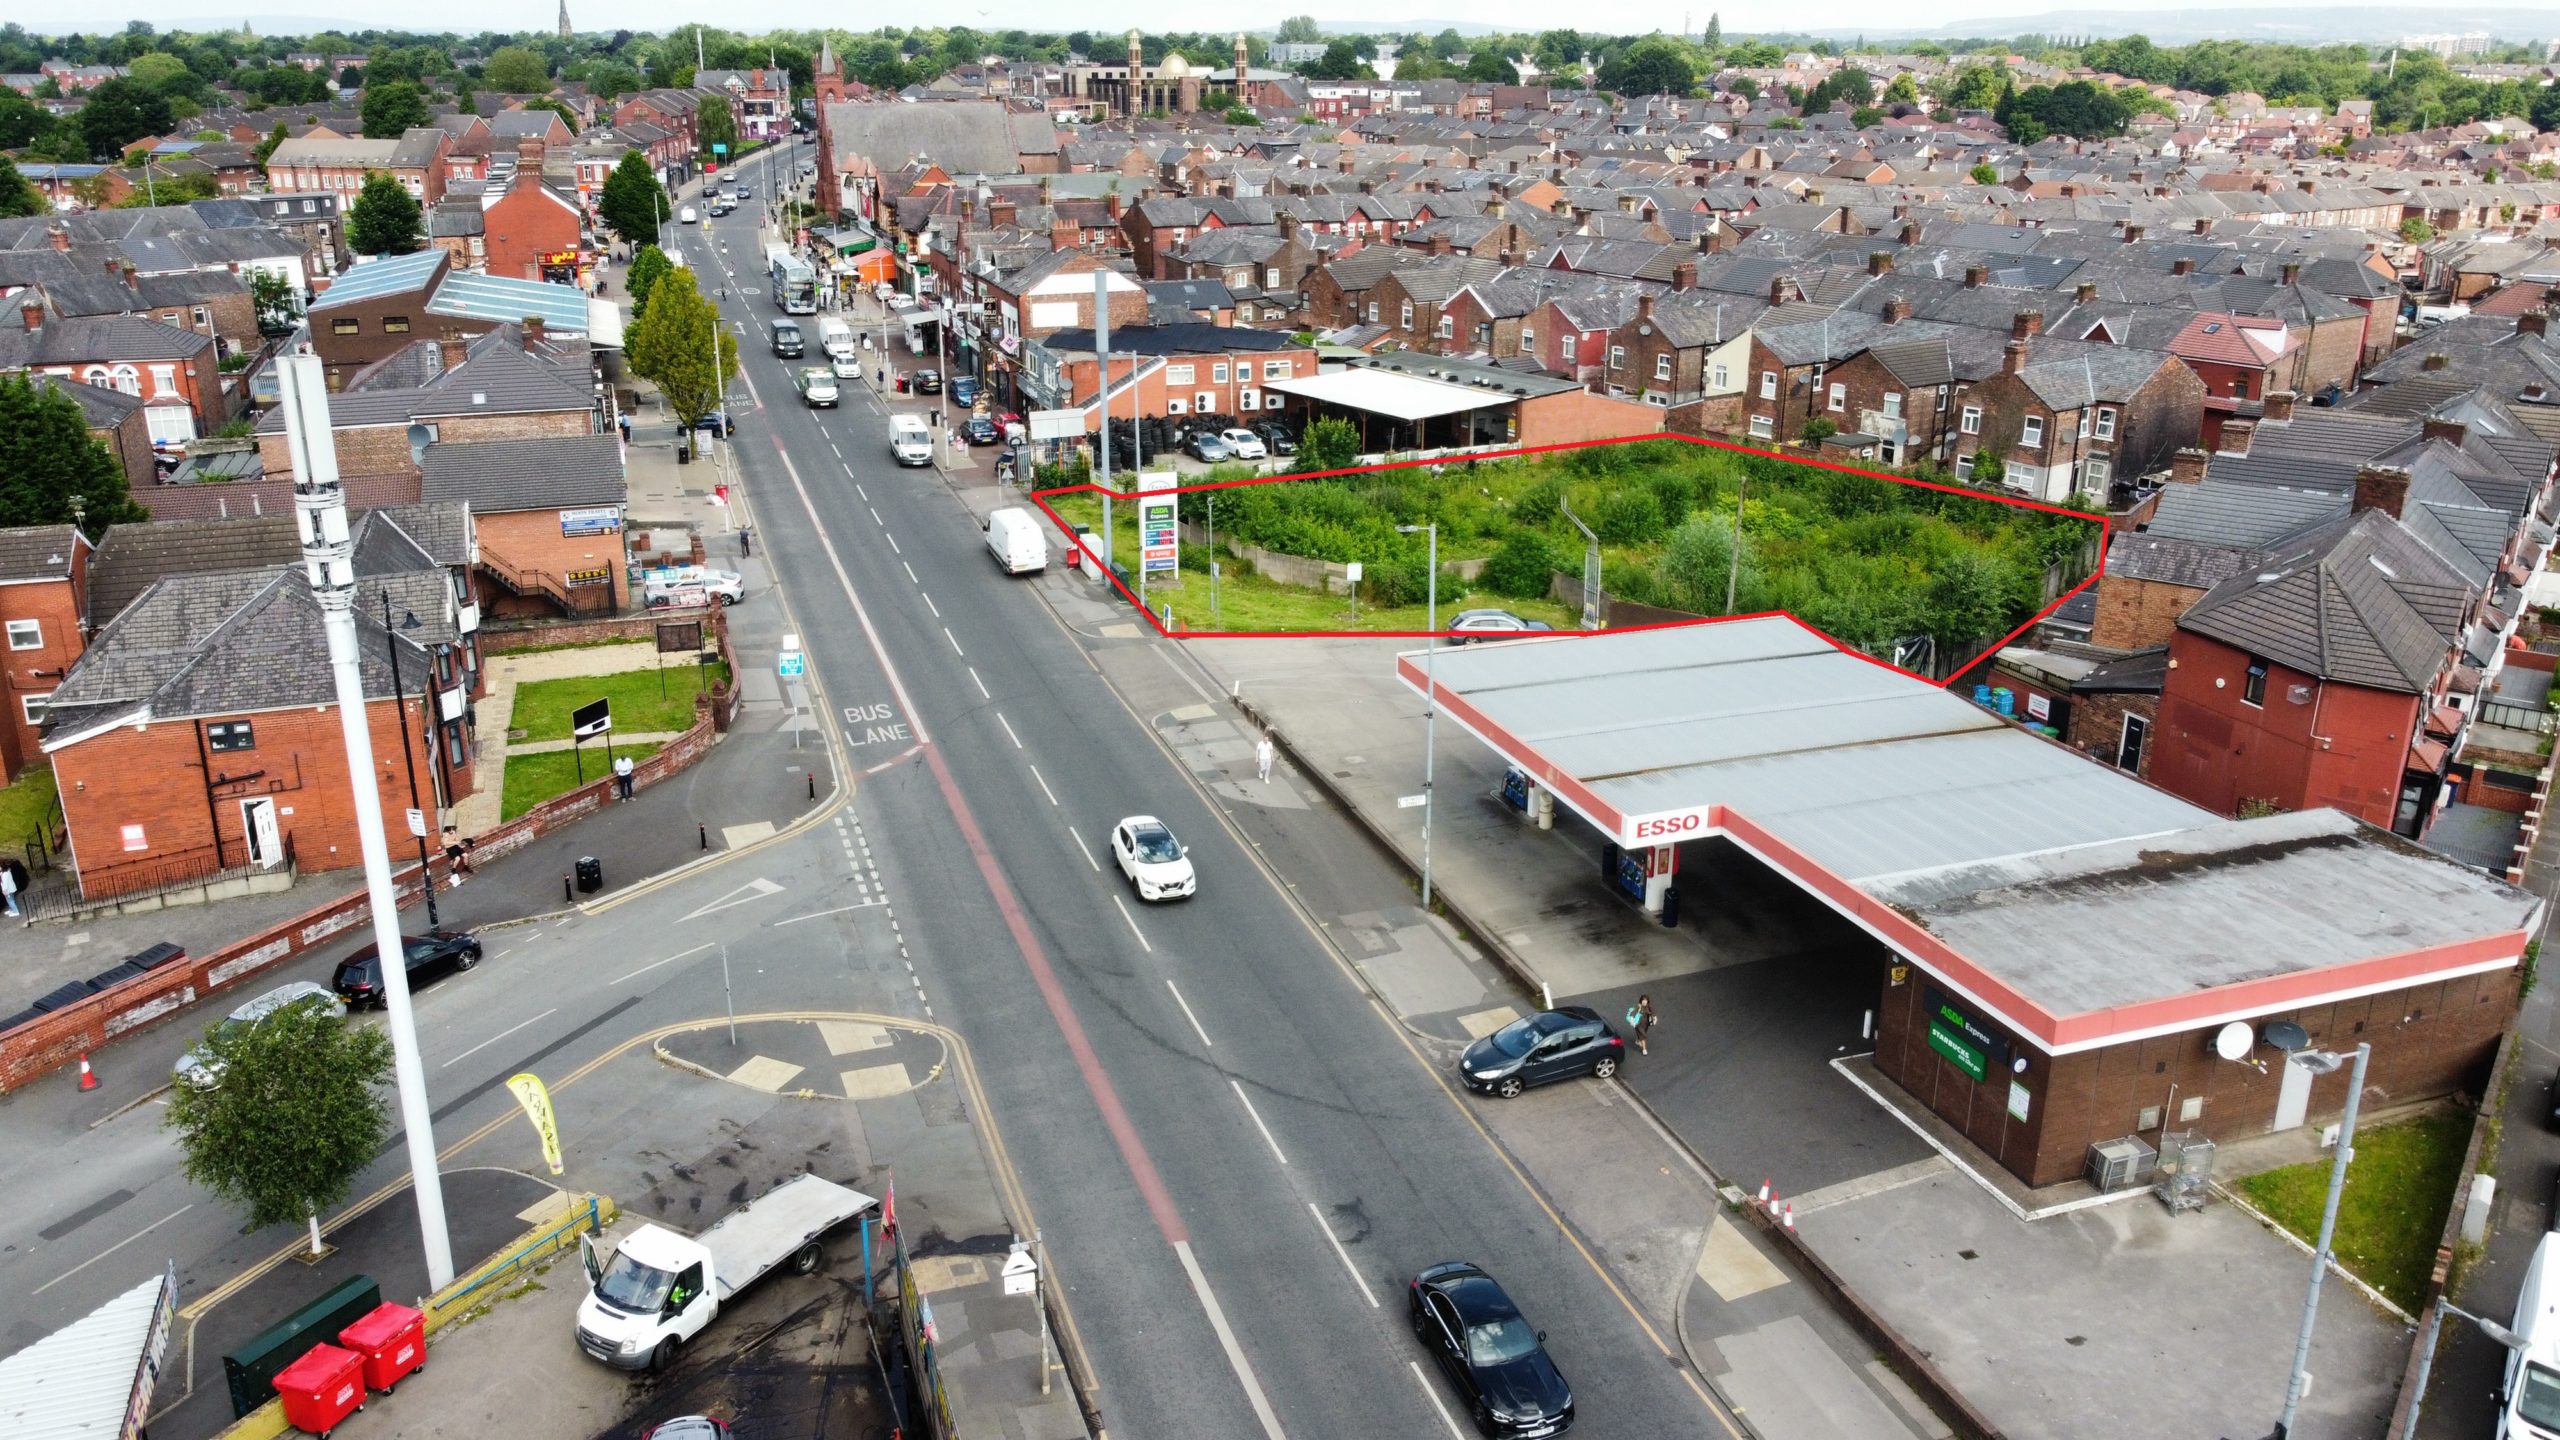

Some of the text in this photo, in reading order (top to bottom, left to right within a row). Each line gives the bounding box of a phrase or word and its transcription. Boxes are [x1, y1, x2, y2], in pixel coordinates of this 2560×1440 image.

[1151, 507, 1169, 515] ASDA
[843, 703, 893, 723] BUS
[845, 723, 913, 746] LANE
[1636, 814, 1700, 838] ESSO
[1940, 1005, 1991, 1045] ASDA Express
[1932, 1028, 1970, 1059] STARBUCKS
